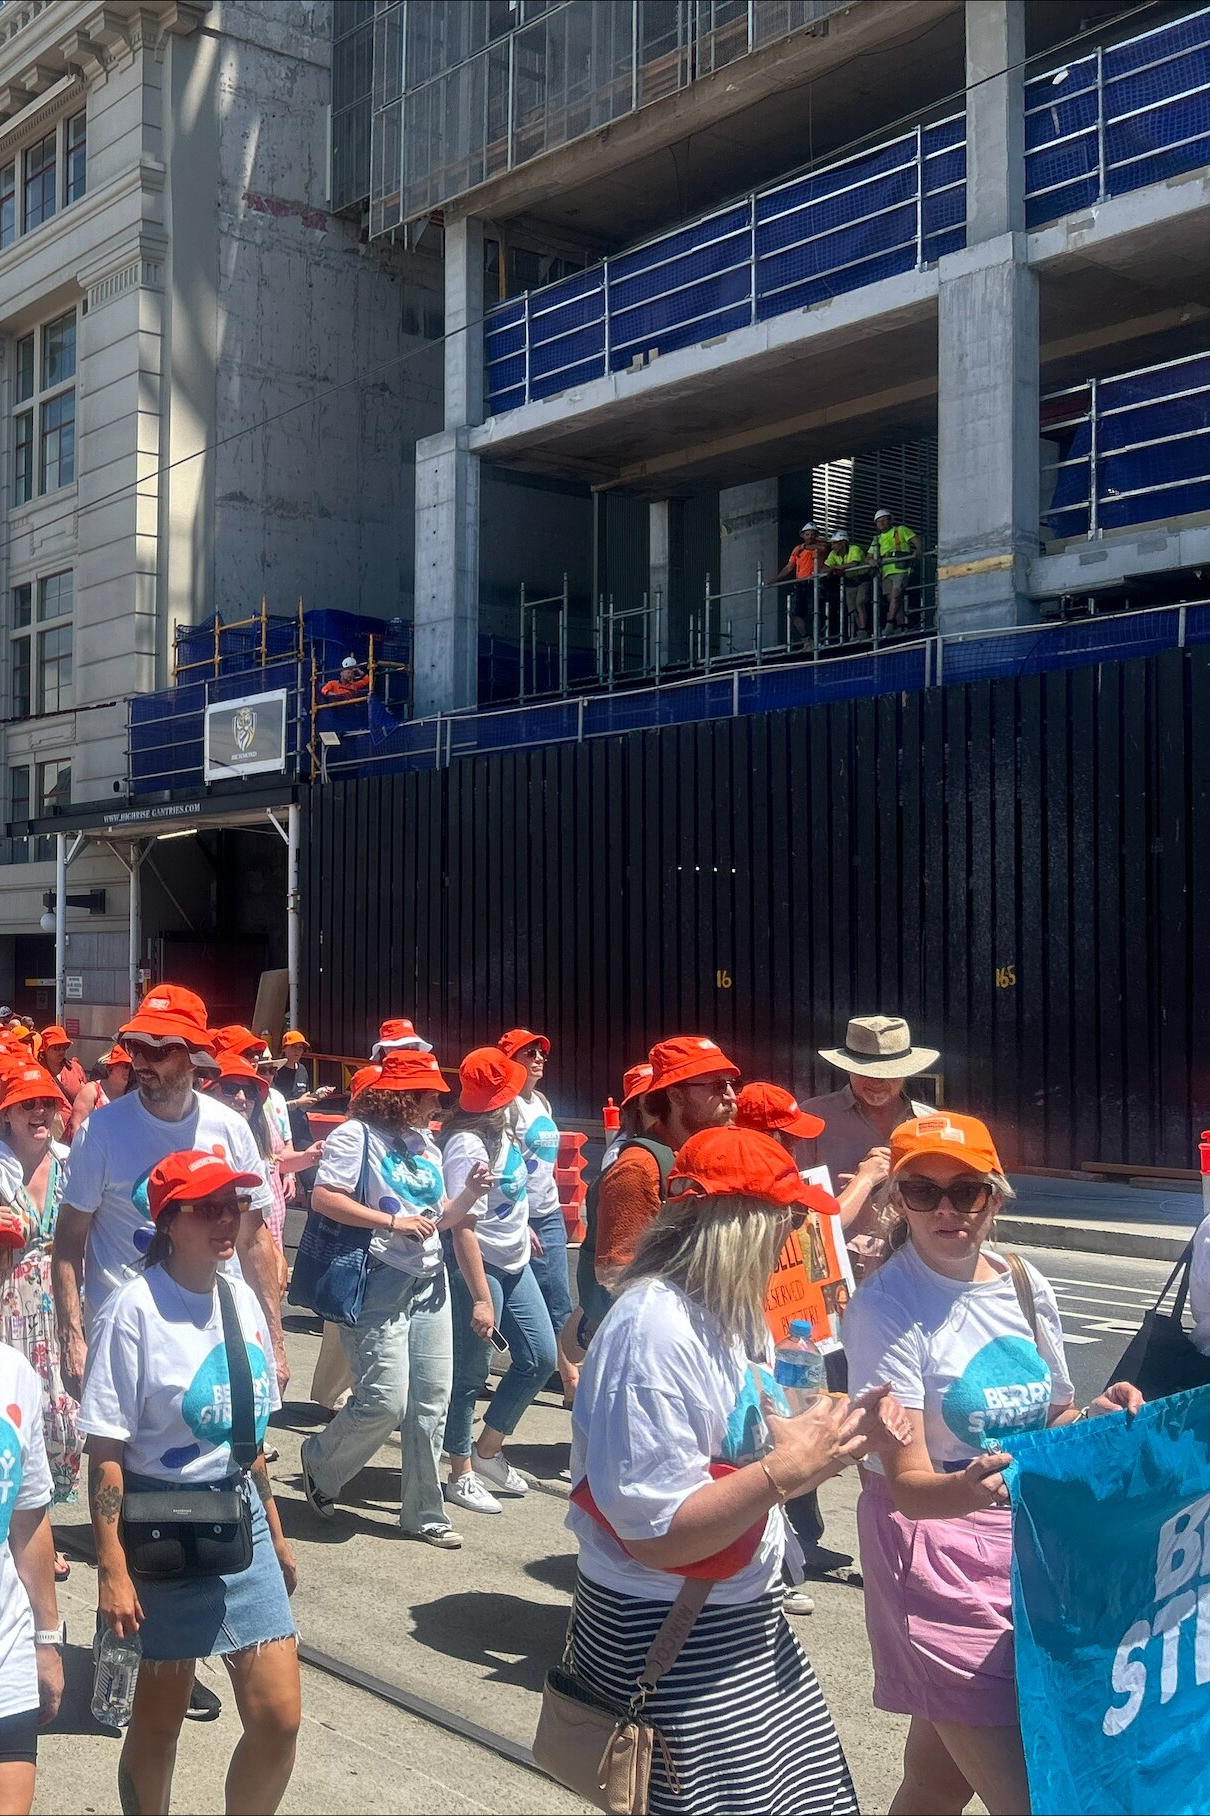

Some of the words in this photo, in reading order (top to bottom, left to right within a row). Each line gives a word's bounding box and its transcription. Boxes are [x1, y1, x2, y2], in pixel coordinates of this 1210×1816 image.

[151, 803, 201, 817] GANTRIES.COM
[717, 970, 732, 988] 16
[1153, 1493, 1210, 1603] B
[1102, 1584, 1210, 1737] ST
